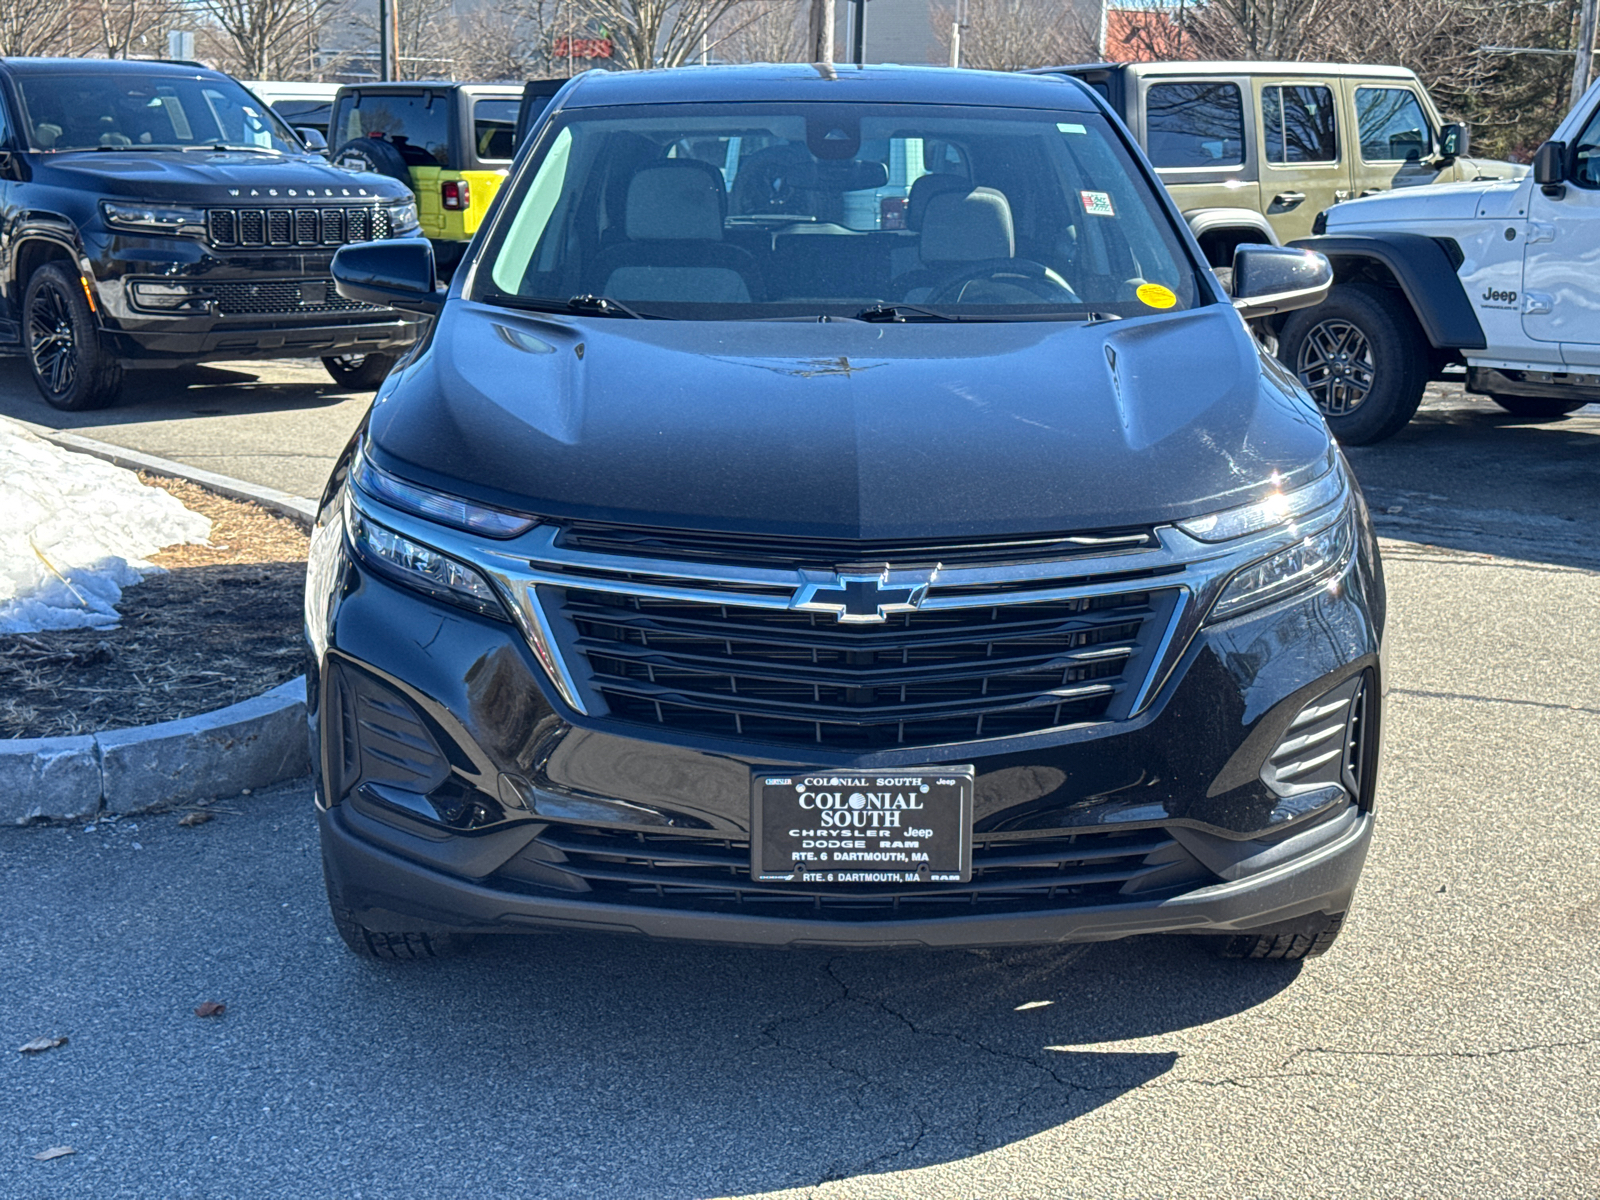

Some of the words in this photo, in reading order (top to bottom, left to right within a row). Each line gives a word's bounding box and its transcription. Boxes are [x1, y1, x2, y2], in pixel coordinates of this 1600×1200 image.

[1482, 286, 1517, 304] Jeep
[876, 777, 922, 786] SOUTH
[936, 778, 956, 786] Jeep
[821, 810, 901, 828] SOUTH
[788, 829, 891, 837] CHRYSLER
[903, 826, 933, 839] Jeep
[802, 840, 866, 849] DODGE
[879, 841, 919, 849] RAM
[791, 852, 817, 861] RTE.
[820, 852, 828, 861] 6
[833, 852, 909, 862] DARTMOUTH,
[911, 852, 929, 861] MA
[803, 873, 826, 882] RTE.
[827, 873, 833, 882] 6
[838, 873, 903, 883] DARTMOUTH,
[905, 873, 920, 882] MA
